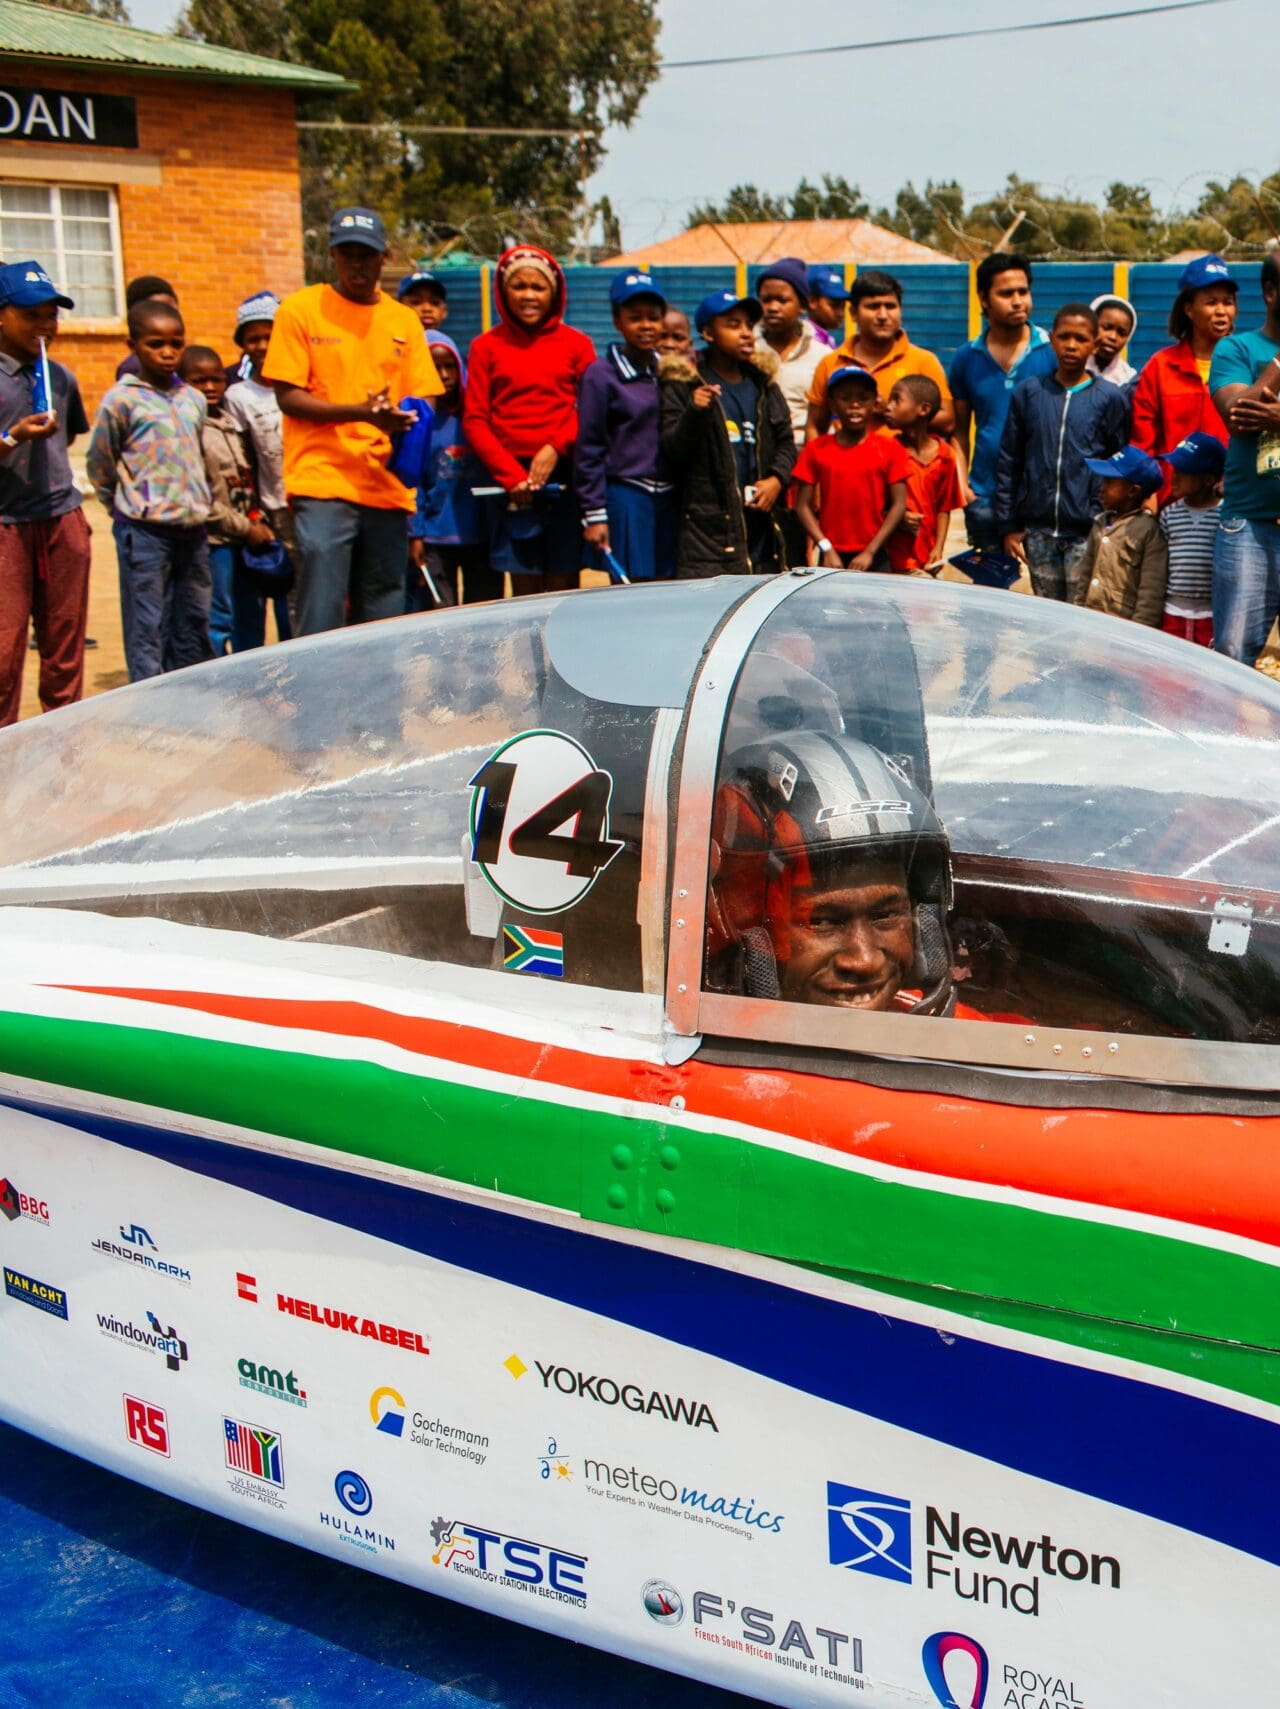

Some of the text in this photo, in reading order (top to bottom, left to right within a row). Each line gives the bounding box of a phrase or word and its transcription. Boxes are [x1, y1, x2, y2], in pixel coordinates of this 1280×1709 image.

[469, 760, 625, 880] 14
[816, 800, 914, 823] LS2
[20, 1193, 49, 1219] BBG
[91, 1238, 191, 1280] JENDAMARK
[6, 1271, 62, 1305] VAN ACHT
[96, 1313, 179, 1356] windowart
[277, 1293, 430, 1355] HELUKABEL
[534, 1360, 719, 1433] YOKOGAWA
[126, 1397, 168, 1453] RS
[410, 1430, 487, 1465] Solar Technology
[413, 1412, 489, 1447] Gochermann
[230, 1484, 285, 1510] SOUTH AFRICA
[234, 1475, 245, 1486] US
[584, 1458, 785, 1533] meteomatics
[320, 1511, 395, 1550] HULAMIN
[585, 1484, 755, 1540] Your Experts in Weather Data Processing.
[463, 1527, 587, 1599] TSE
[926, 1505, 1120, 1589] Newton
[453, 1561, 587, 1609] TECHNOLOGY STATION IN ELECTRONICS
[927, 1550, 1039, 1616] Fund
[695, 1627, 864, 1690] French South African Institute of Technology
[1003, 1664, 1084, 1704] ROYAL
